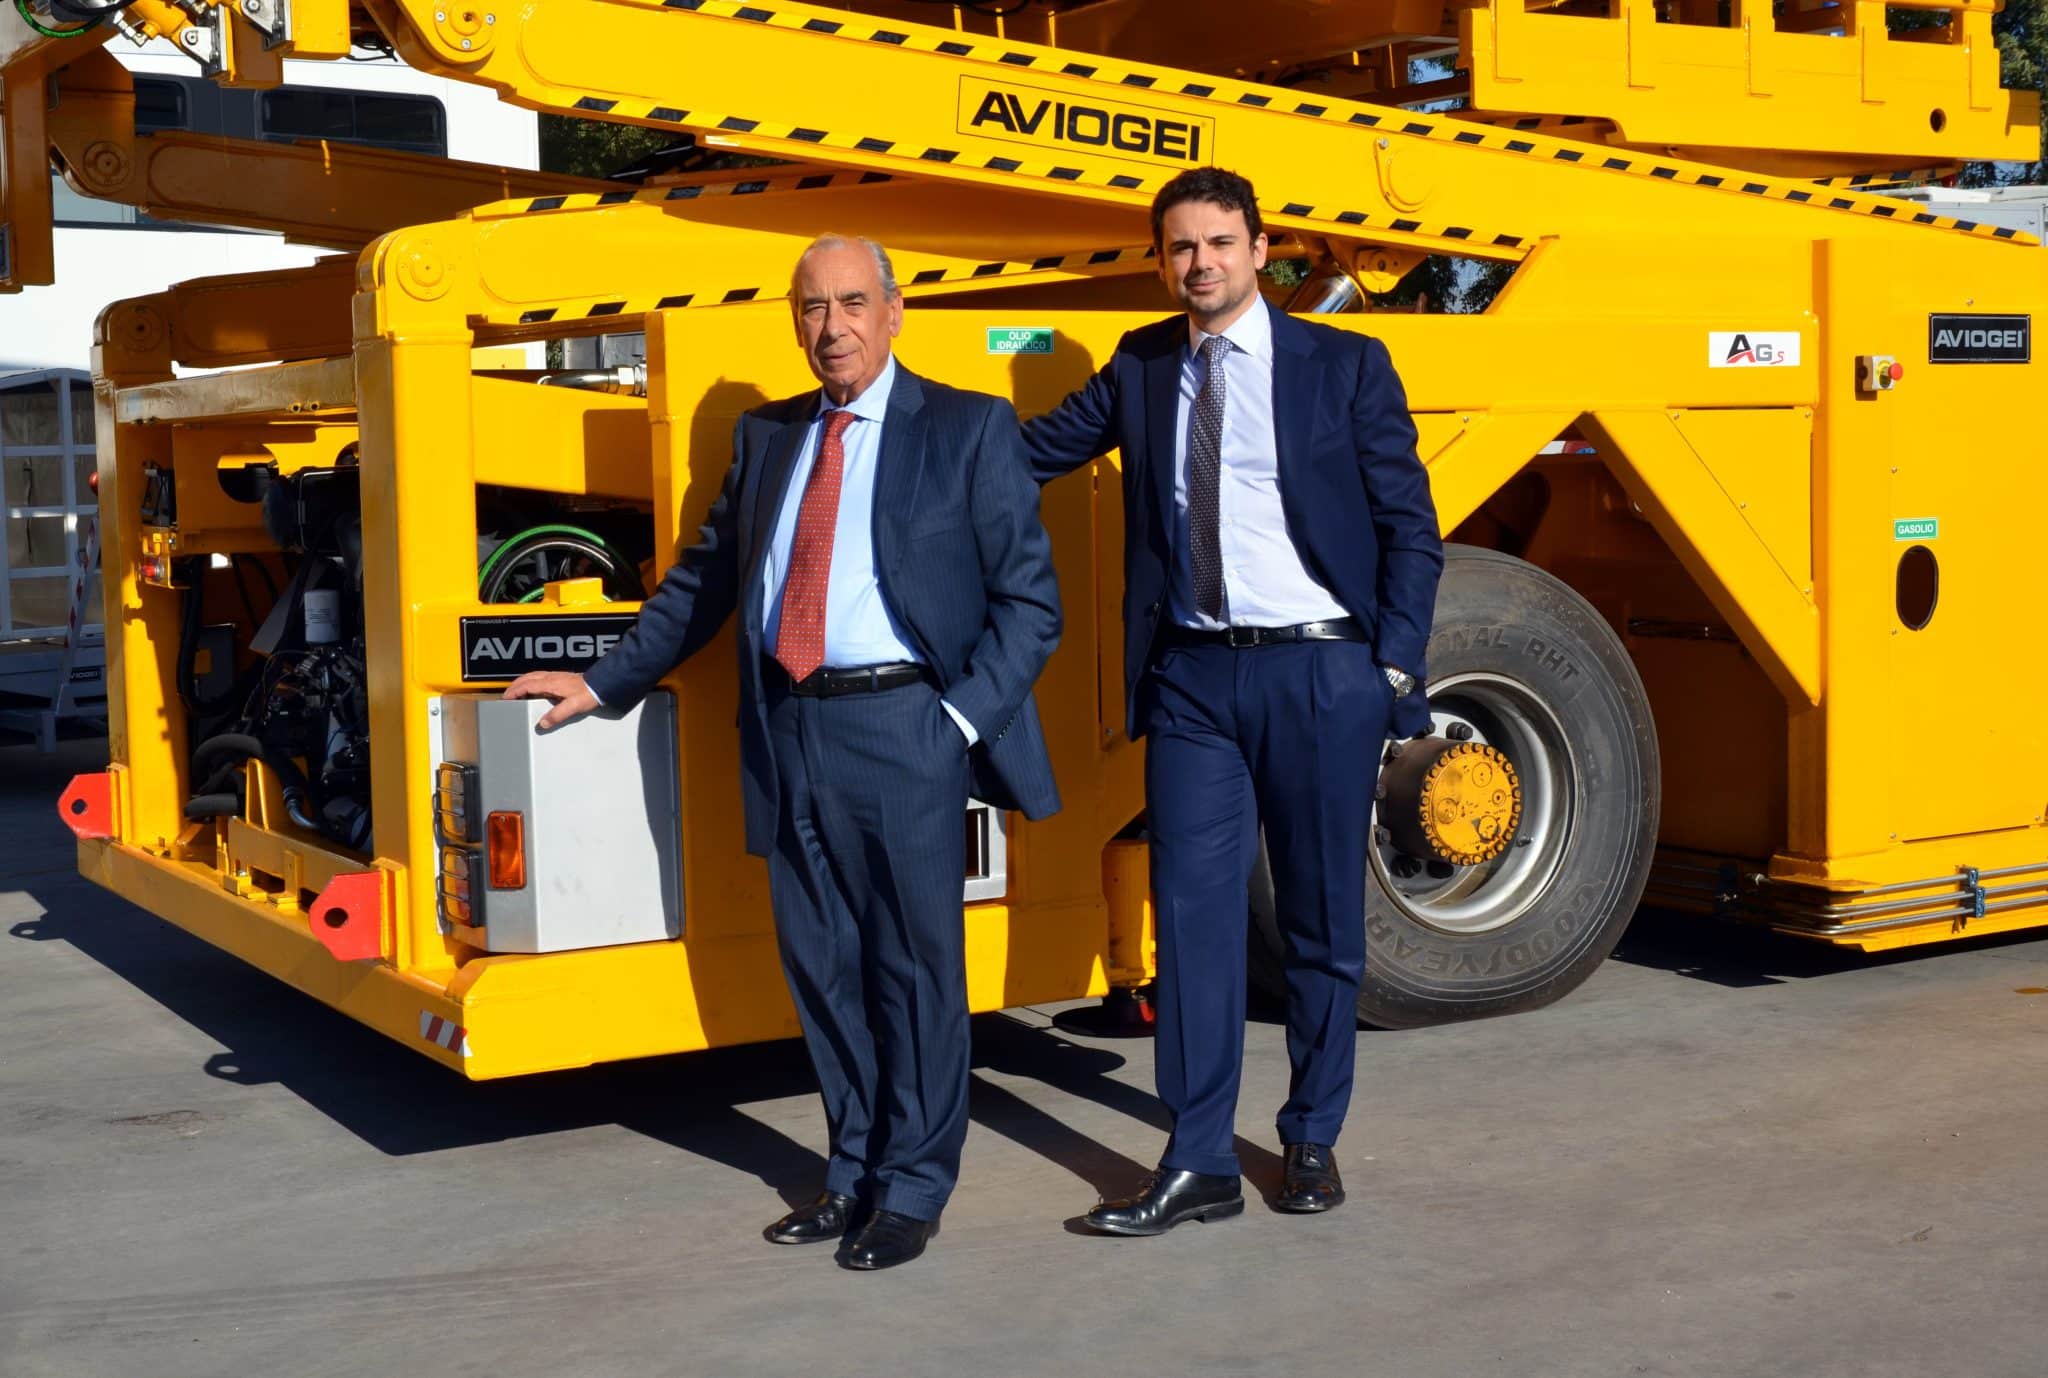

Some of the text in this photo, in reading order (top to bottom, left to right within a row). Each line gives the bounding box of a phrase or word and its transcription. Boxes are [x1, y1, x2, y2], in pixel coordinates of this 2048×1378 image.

[970, 91, 1201, 161] AVIOGEI
[1008, 331, 1031, 340] OLIO
[1934, 329, 2023, 348] AVIOGEI
[996, 341, 1046, 350] IDRAULICO
[1897, 523, 1935, 535] GASOLIO
[470, 634, 621, 660] AVIOGE
[1365, 878, 1607, 978] GOODYEAR
